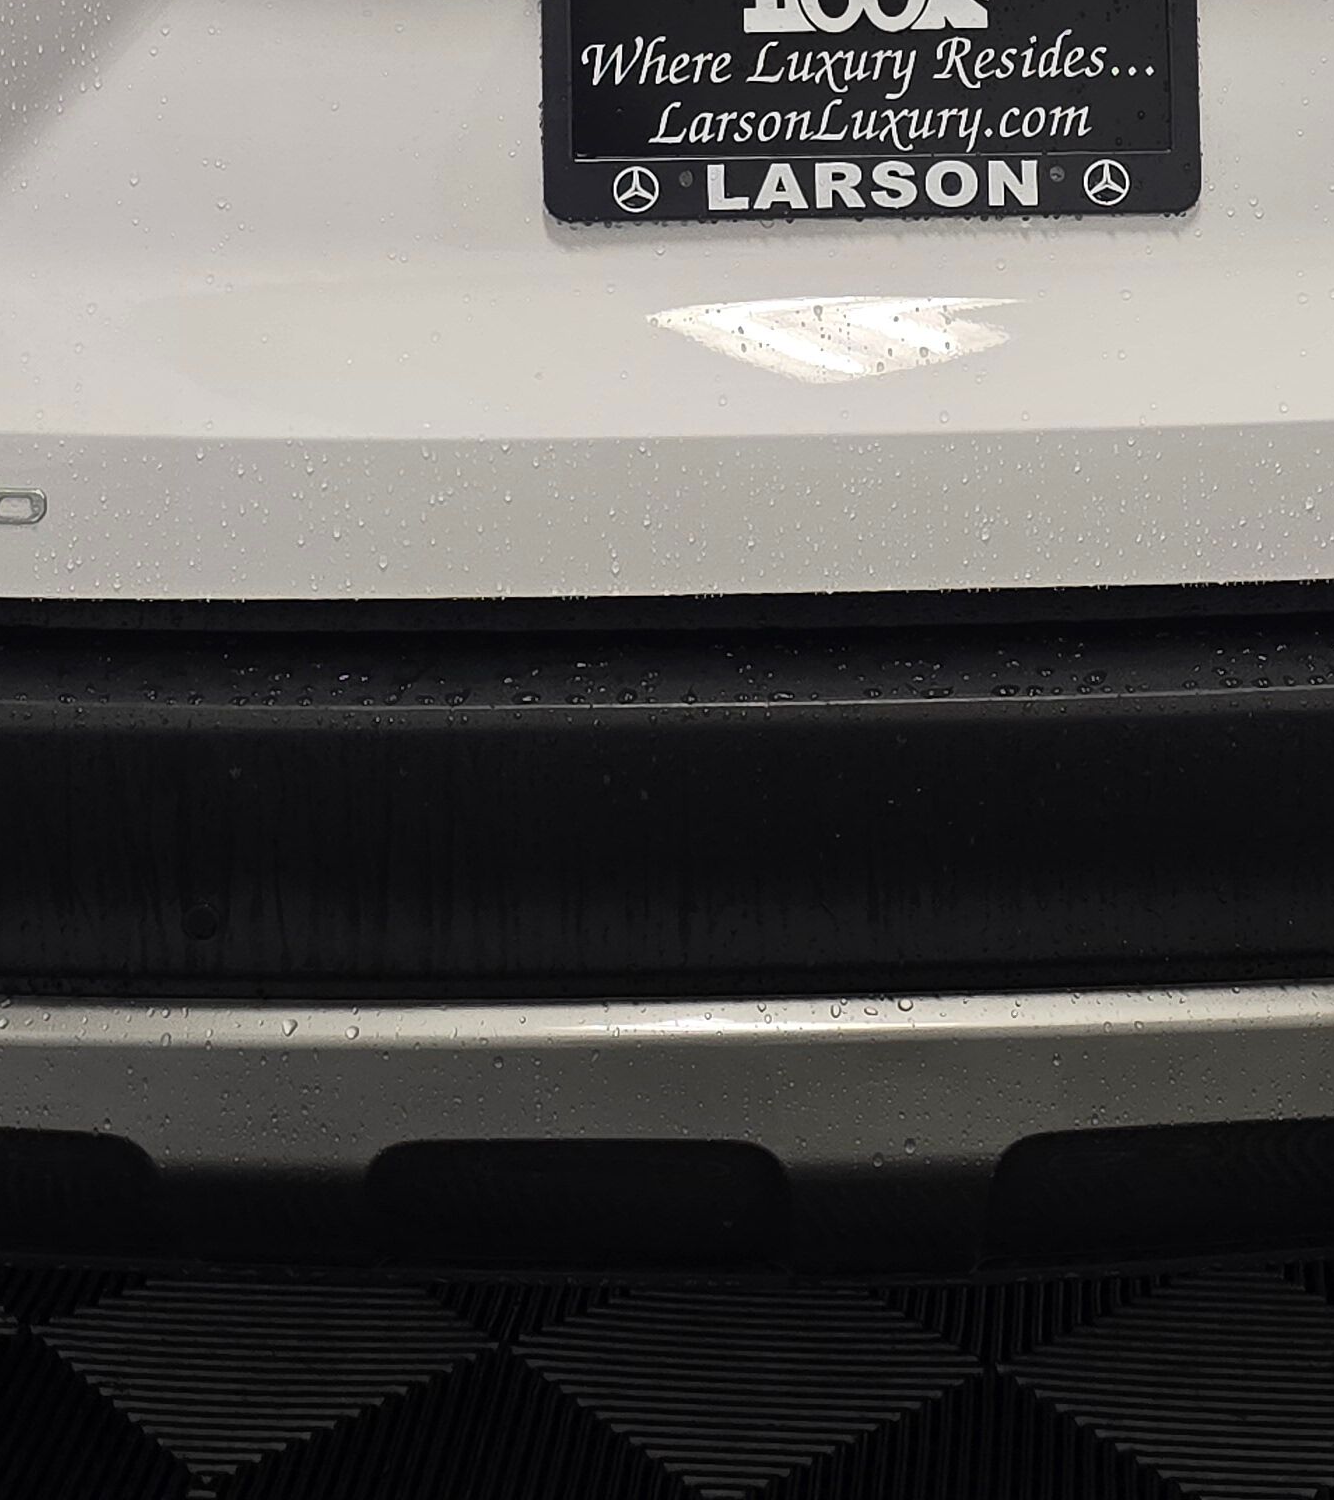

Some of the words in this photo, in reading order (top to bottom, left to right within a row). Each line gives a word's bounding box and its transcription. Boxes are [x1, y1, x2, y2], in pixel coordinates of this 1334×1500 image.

[581, 35, 732, 86] Where
[745, 41, 917, 100] Luxury
[932, 28, 1155, 89] Resides...
[648, 98, 1092, 153] LarsonLuxury.com
[706, 159, 1039, 211] LARSON
